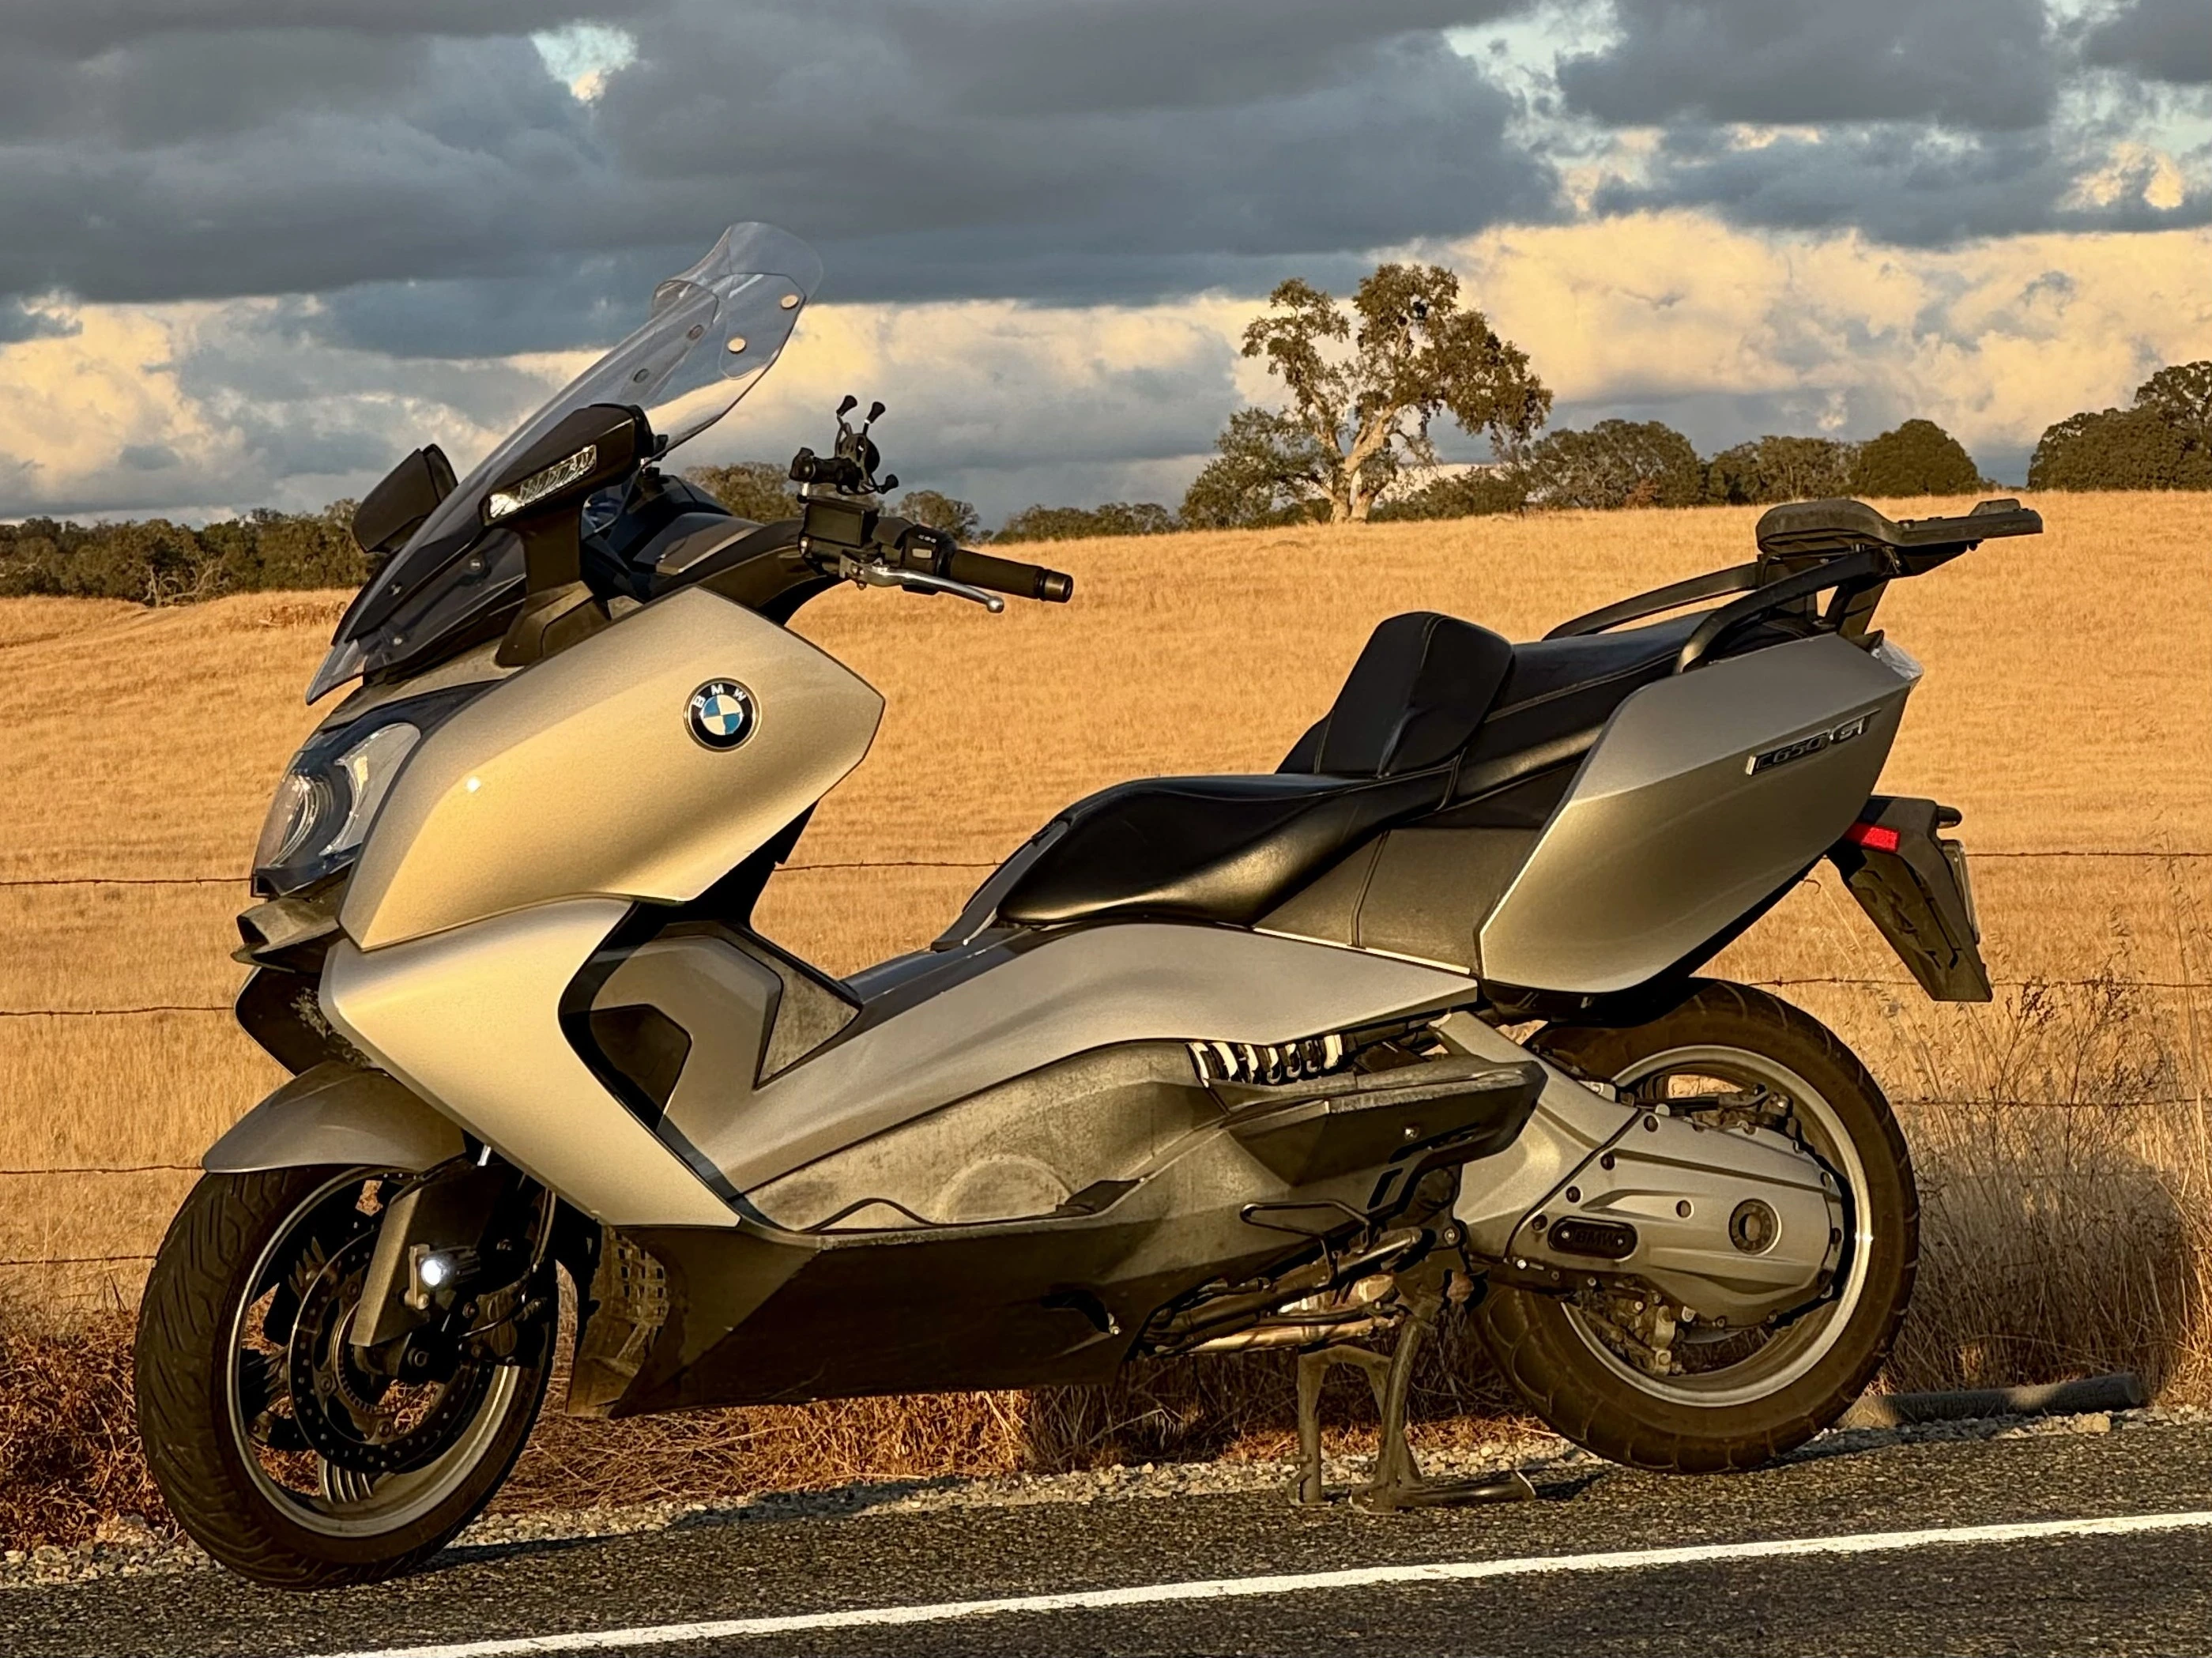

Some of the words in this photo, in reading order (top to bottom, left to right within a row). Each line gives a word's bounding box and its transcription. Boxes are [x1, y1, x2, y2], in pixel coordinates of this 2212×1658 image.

[691, 684, 747, 708] BMW
[1829, 710, 1876, 743] GT
[1573, 1228, 1618, 1249] BMW
